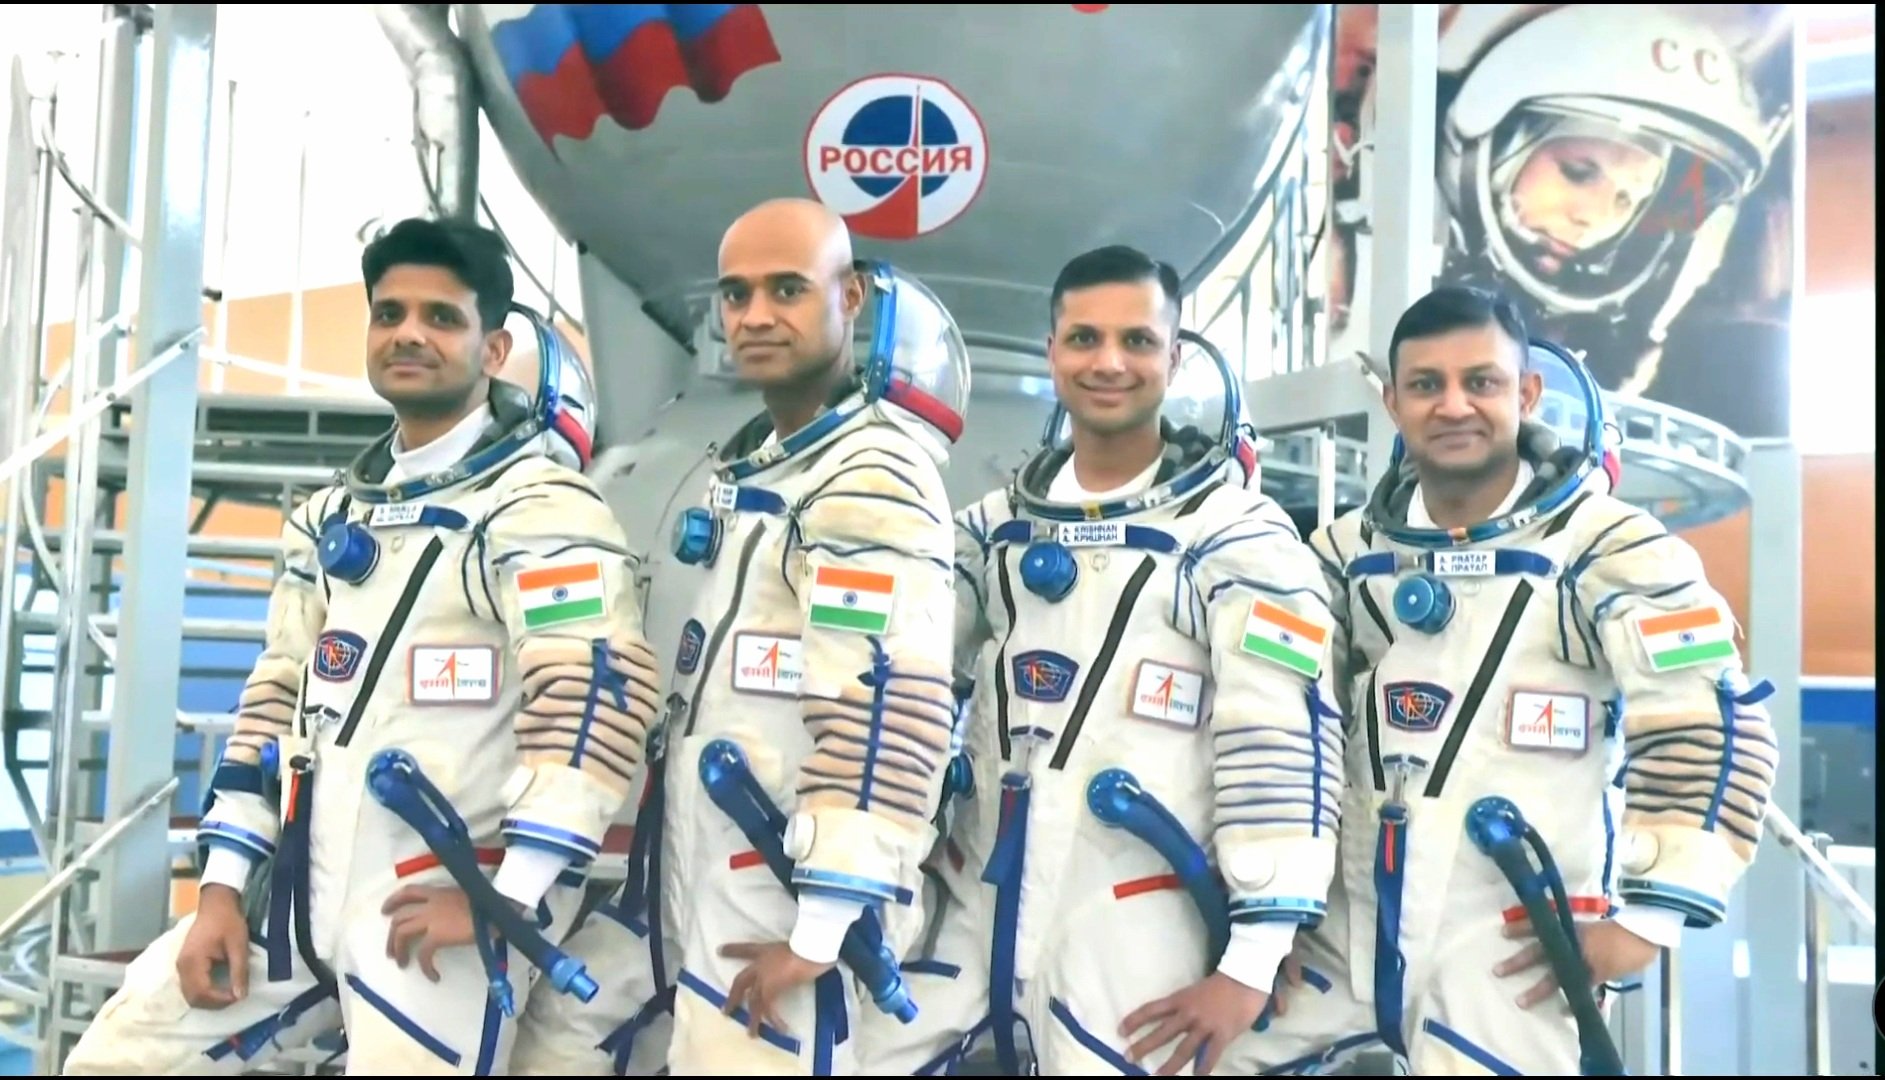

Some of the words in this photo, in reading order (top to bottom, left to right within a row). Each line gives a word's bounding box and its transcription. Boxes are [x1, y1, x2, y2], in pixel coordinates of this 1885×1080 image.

[819, 145, 973, 175] РОССИЯ
[1074, 523, 1118, 534] KRISHNAN
[1451, 553, 1488, 563] PRATAP
